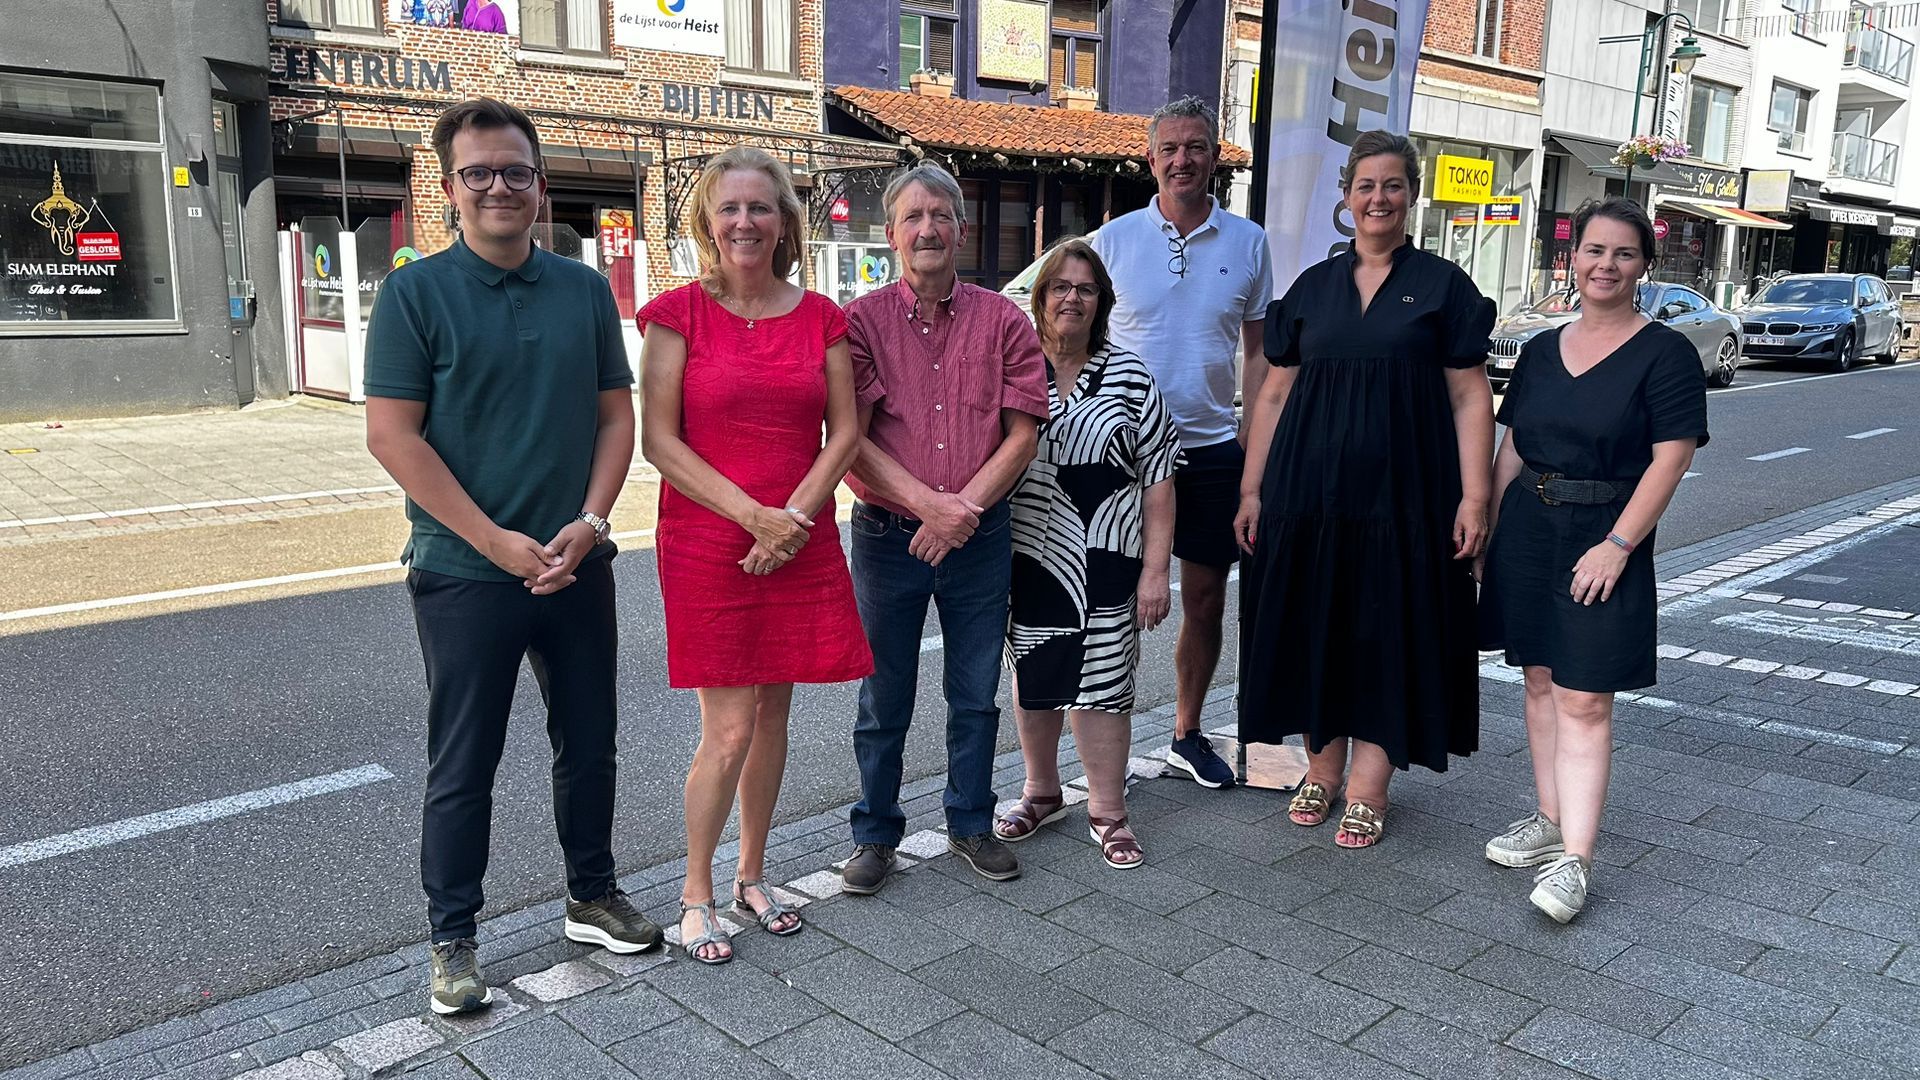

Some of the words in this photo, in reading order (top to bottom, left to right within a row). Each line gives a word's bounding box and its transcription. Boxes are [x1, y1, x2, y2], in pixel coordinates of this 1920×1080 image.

[619, 13, 632, 24] de
[635, 15, 656, 28] Lijst
[659, 19, 682, 29] voor
[684, 18, 719, 34] Heist
[1327, 0, 1398, 147] Hei
[663, 83, 700, 122] BIJ
[710, 87, 774, 122] FIEN
[1453, 187, 1482, 196] FASHION
[832, 202, 849, 219] illy
[79, 245, 119, 254] GESLOTEN
[8, 263, 43, 276] SIAM
[46, 263, 117, 276] ELEPHANT
[28, 284, 54, 295] Thai
[56, 284, 66, 294] &
[69, 284, 102, 295] Fusion
[302, 276, 308, 287] de
[308, 278, 318, 290] Lijst
[318, 279, 329, 288] voor
[330, 276, 343, 290] Heis
[359, 280, 372, 291] de
